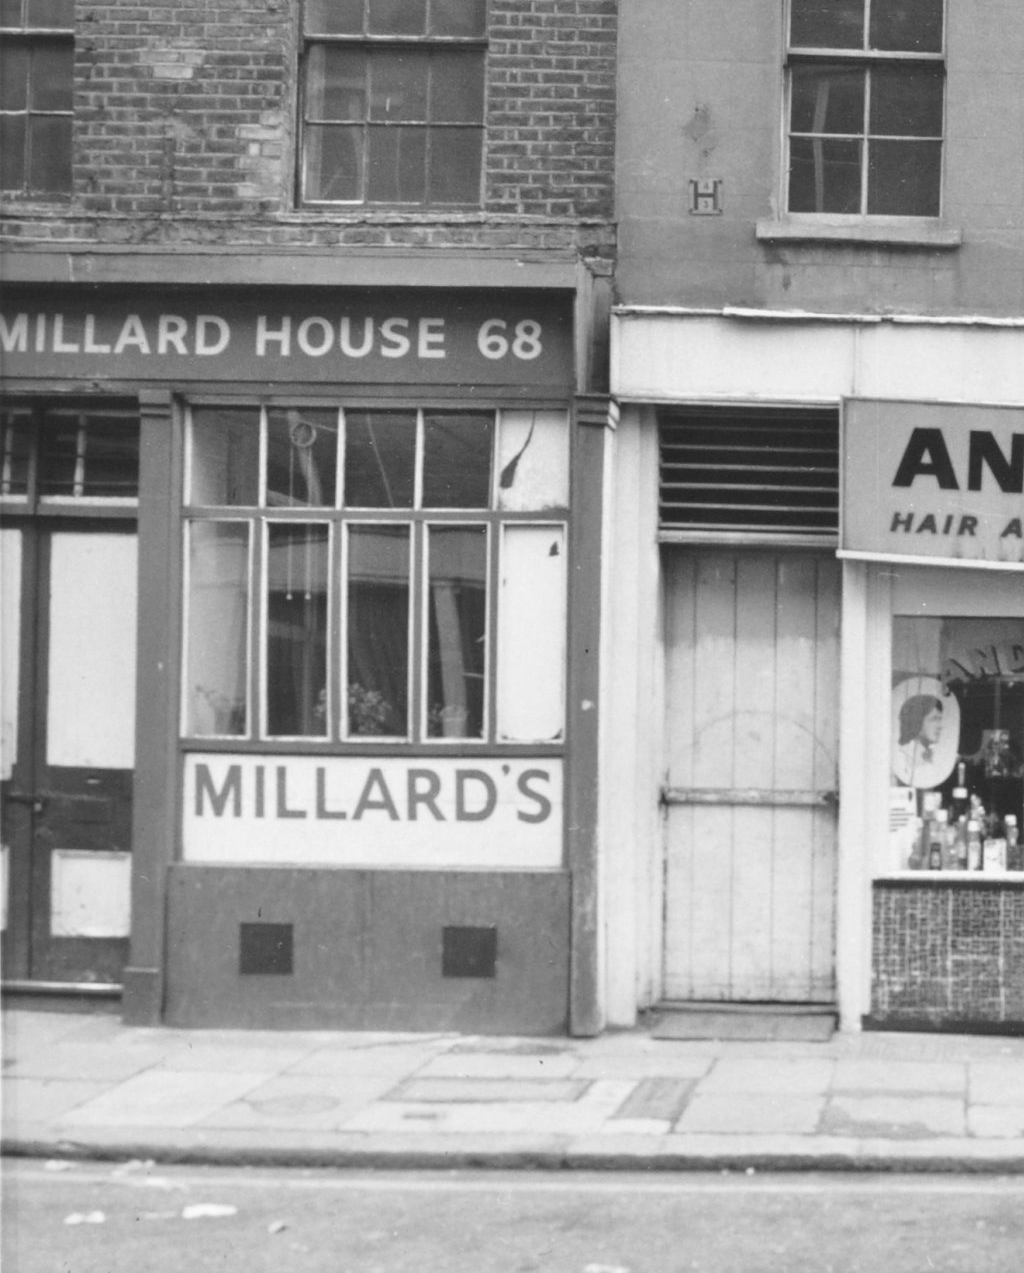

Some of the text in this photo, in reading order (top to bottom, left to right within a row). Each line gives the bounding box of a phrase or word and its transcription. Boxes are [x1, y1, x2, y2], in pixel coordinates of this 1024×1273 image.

[0, 313, 543, 360] MILLARD HOUSE 68
[890, 512, 978, 537] HAIR
[195, 763, 552, 824] MILLARD'S
